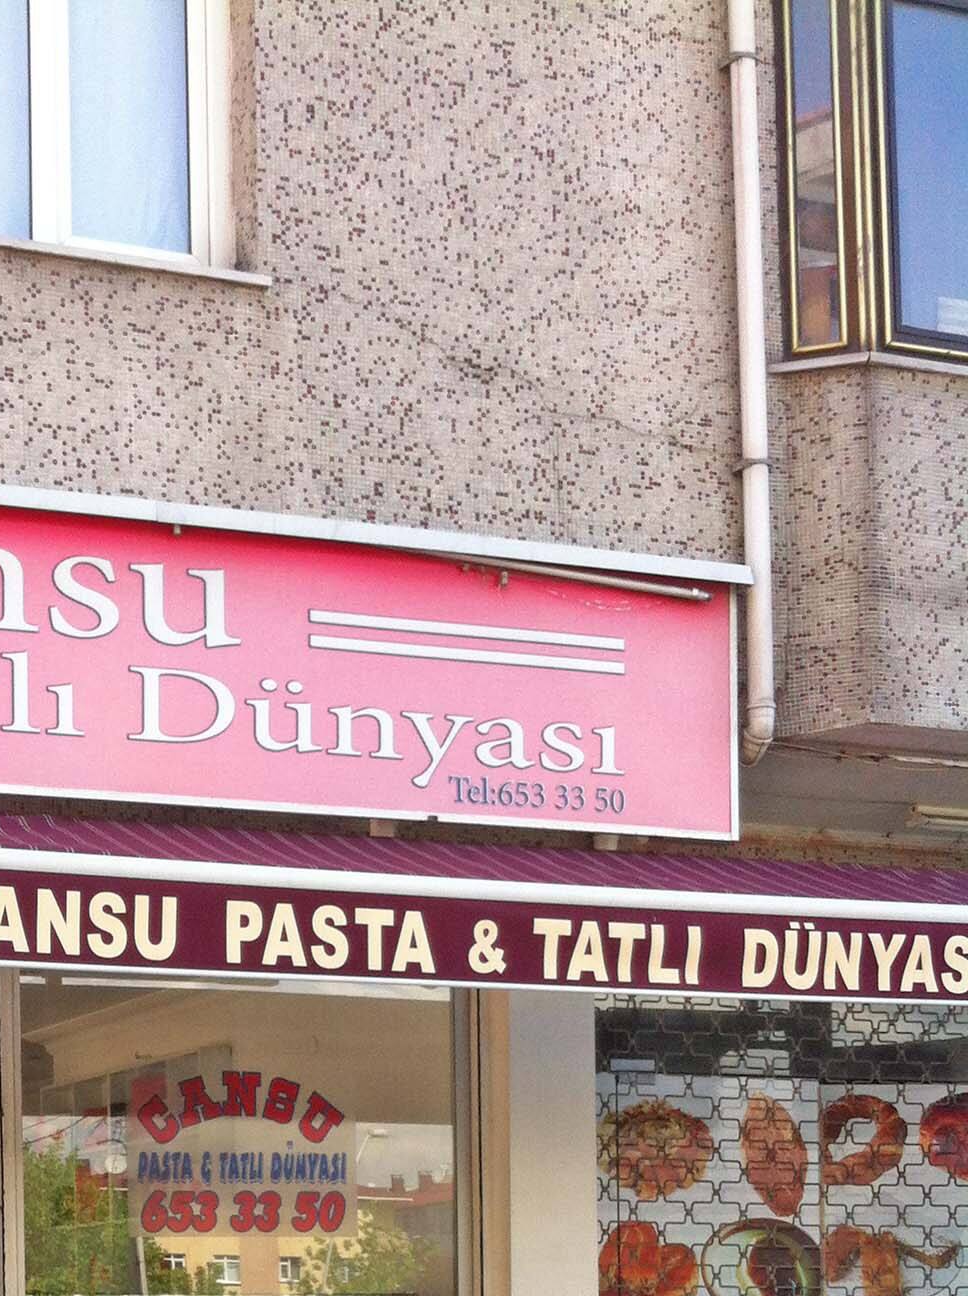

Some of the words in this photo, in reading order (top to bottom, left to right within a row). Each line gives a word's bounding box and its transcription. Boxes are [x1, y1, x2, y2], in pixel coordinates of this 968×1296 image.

[128, 664, 626, 788] Dünyası
[554, 784, 585, 811] 33
[594, 787, 626, 815] 50
[226, 898, 436, 976] PASTA
[468, 918, 507, 974] &
[532, 915, 702, 987] TATLI
[137, 1070, 345, 1144] CANSU
[137, 1151, 193, 1184] PASTA
[219, 1151, 263, 1184] TATLI
[270, 1140, 346, 1184] DÜNYASI
[141, 1190, 220, 1233] 653
[230, 1190, 281, 1233] 33
[291, 1190, 346, 1233] 50
